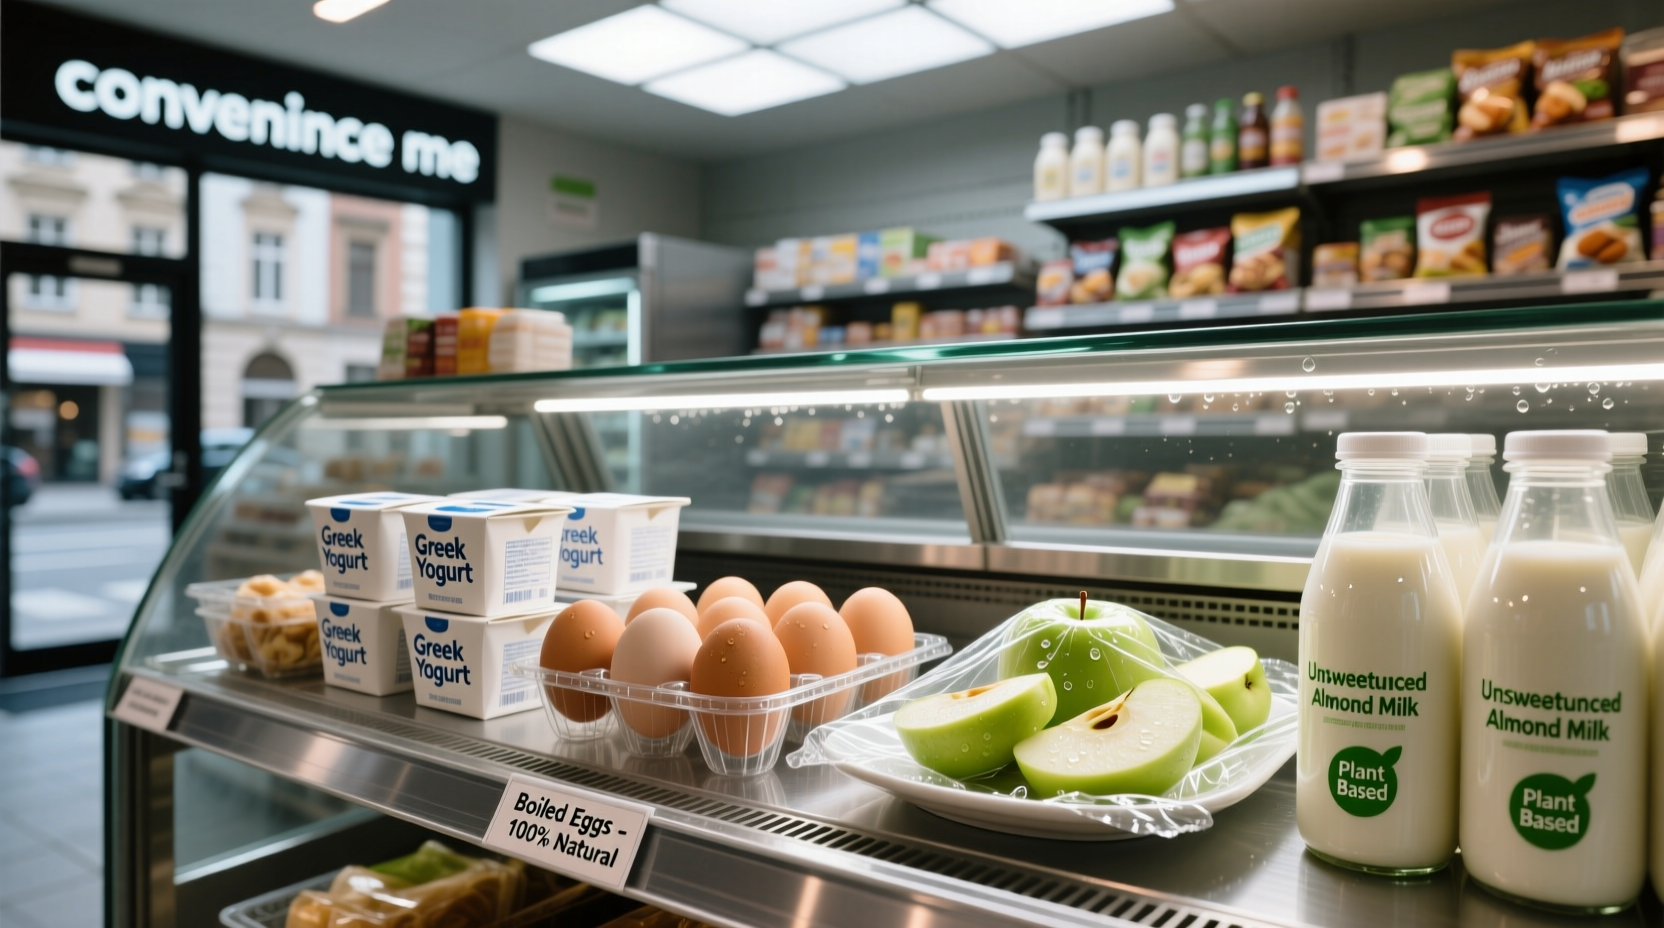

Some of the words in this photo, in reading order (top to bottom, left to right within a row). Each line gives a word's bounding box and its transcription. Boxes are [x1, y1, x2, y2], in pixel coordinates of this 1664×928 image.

[54, 59, 395, 169] convenince
[401, 129, 481, 184] me
[321, 525, 365, 549] Greek
[415, 533, 467, 560] Greek
[561, 525, 599, 545] reek
[322, 547, 369, 574] Yogurt
[415, 556, 474, 587] Yogurt
[560, 547, 604, 569] ogurt
[321, 618, 361, 643] Greek
[323, 639, 367, 667] Yogurt
[413, 633, 465, 662] Greek
[415, 657, 471, 687] Yogurt
[1311, 687, 1373, 715] Almond
[1378, 696, 1419, 717] Milk
[1486, 708, 1561, 738] Almond
[1567, 719, 1611, 742] Milk
[1338, 760, 1385, 782] Plant
[1337, 778, 1388, 802] Based
[1523, 788, 1576, 812] Plant
[513, 791, 569, 822] Boiled
[569, 807, 613, 838] Eggs
[1520, 808, 1580, 834] Based
[508, 818, 551, 847] 100%
[553, 832, 619, 868] Natural
